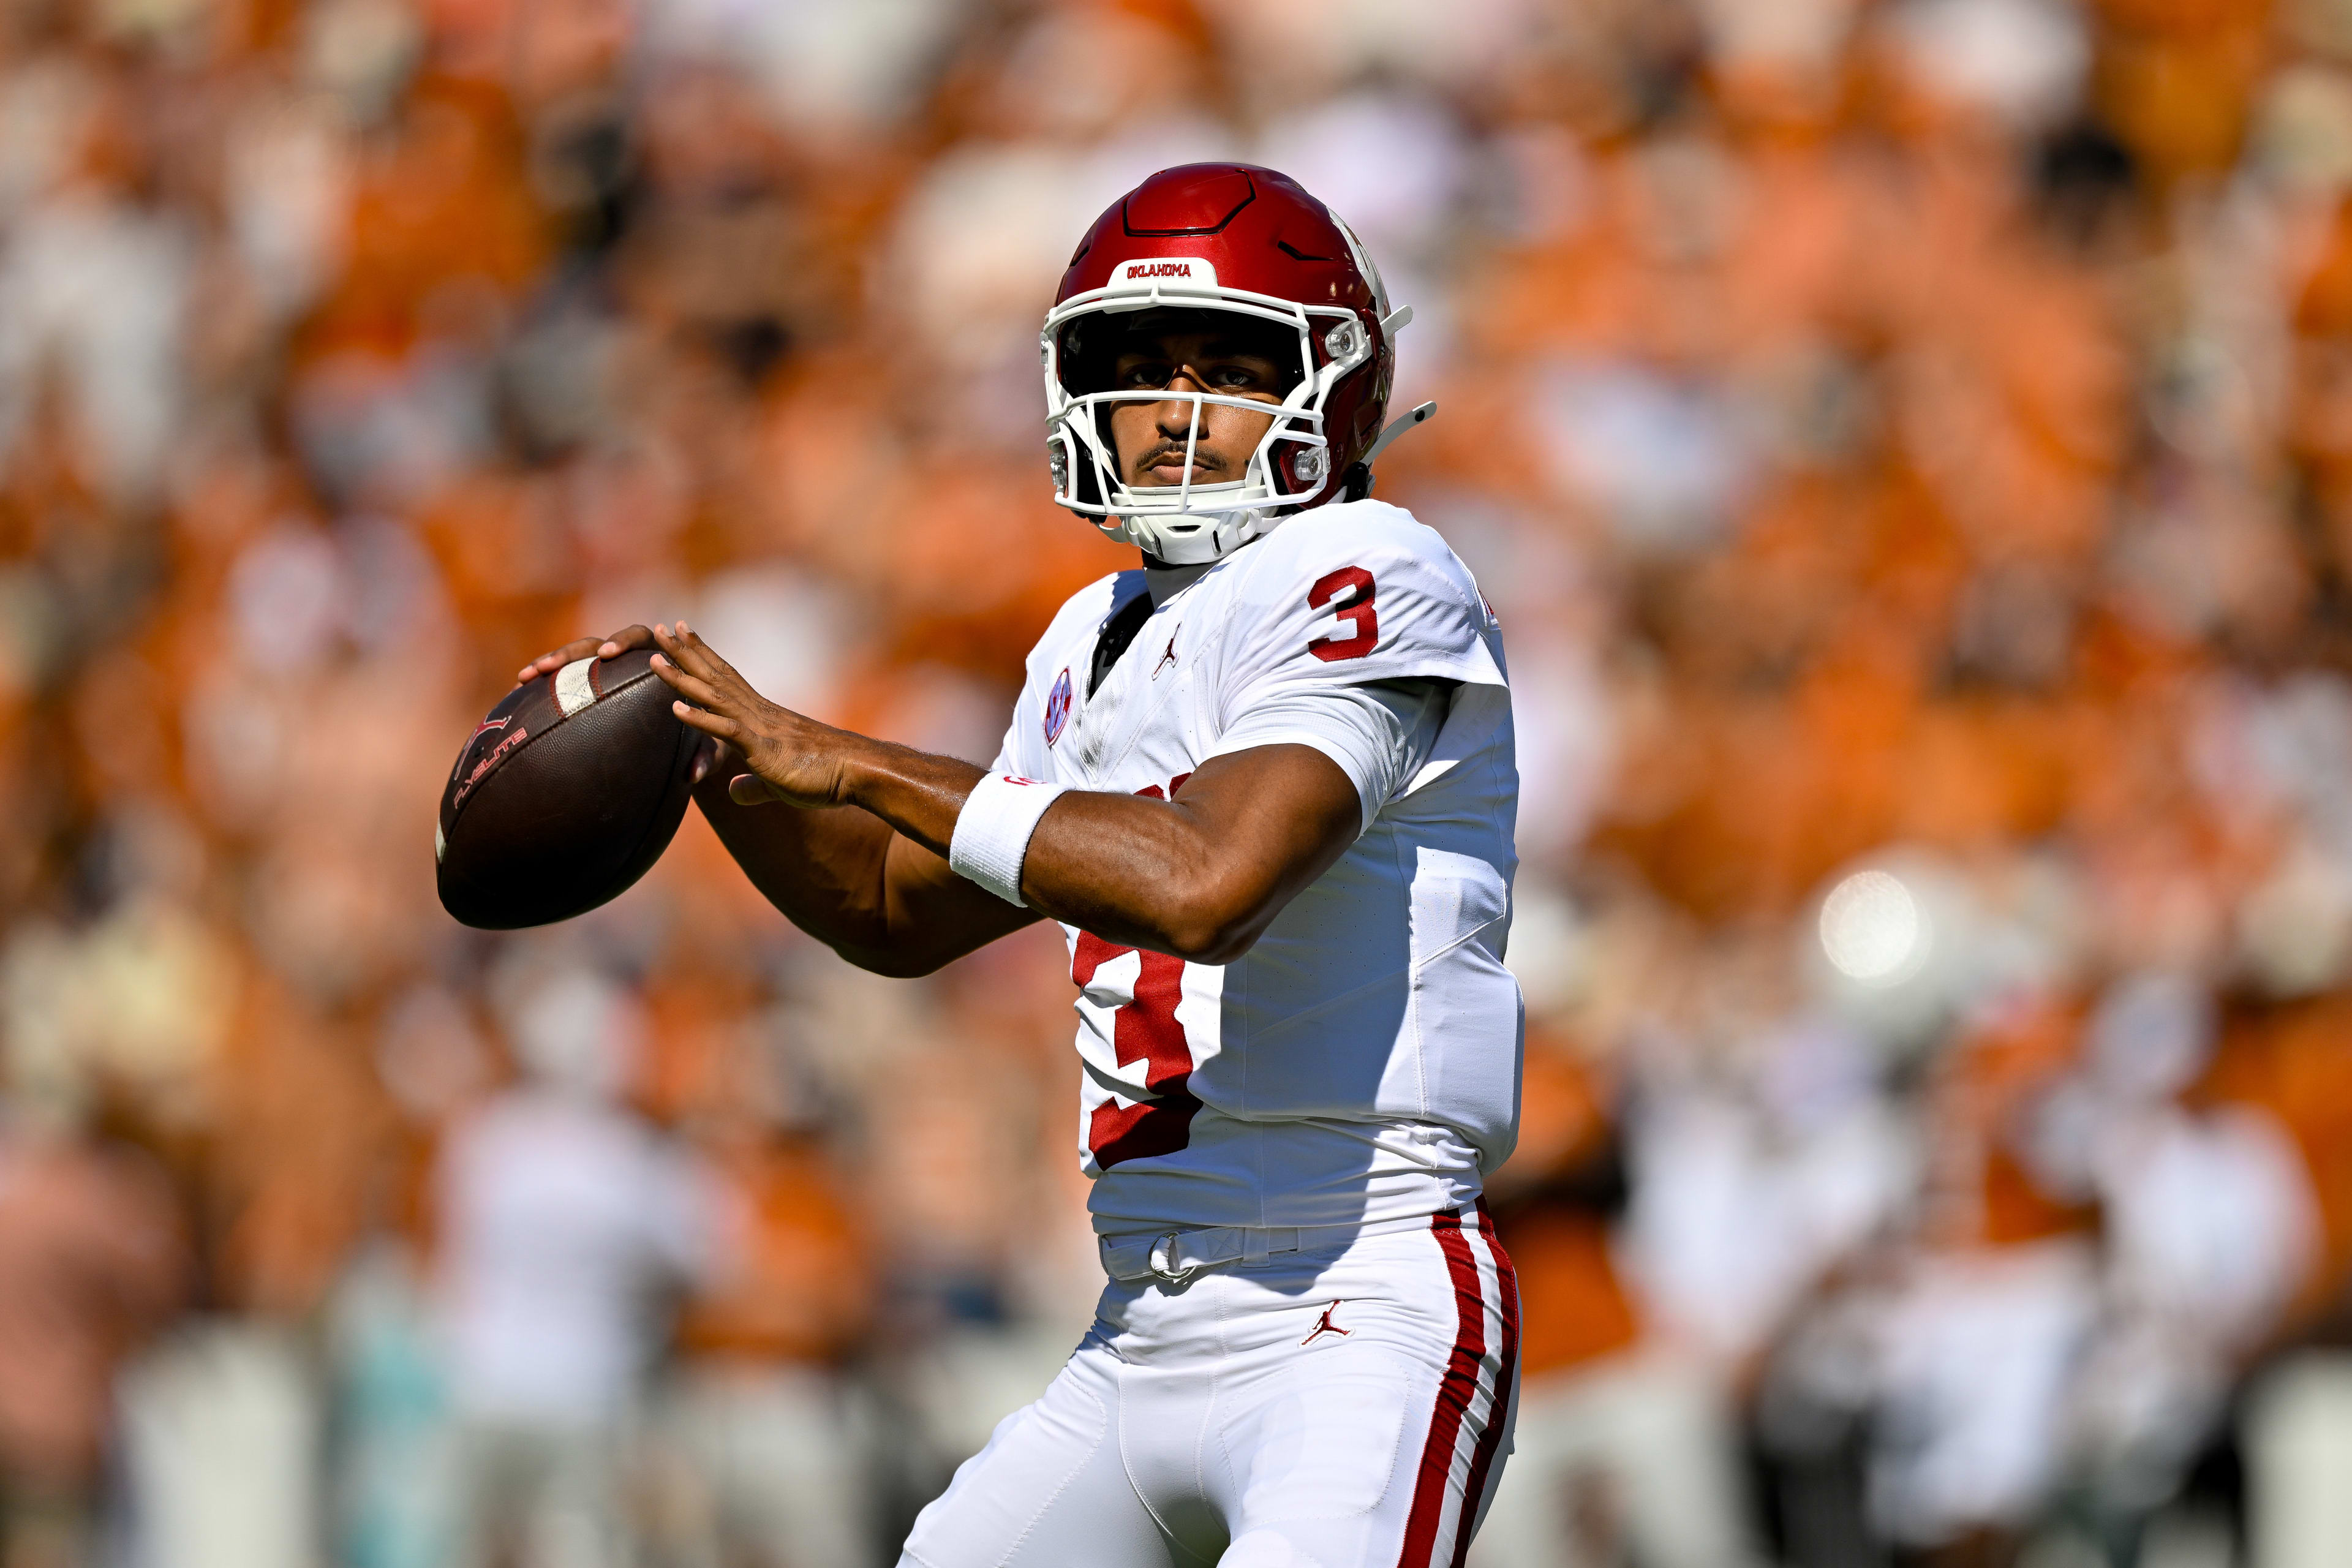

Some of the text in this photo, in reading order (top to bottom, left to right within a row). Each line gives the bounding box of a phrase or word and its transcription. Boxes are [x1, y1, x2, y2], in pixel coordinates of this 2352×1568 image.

[1127, 263, 1191, 279] OKLAHOMA
[1307, 565, 1379, 663] 3
[453, 726, 528, 809] FLYELITE
[1072, 929, 1204, 1172] 3
